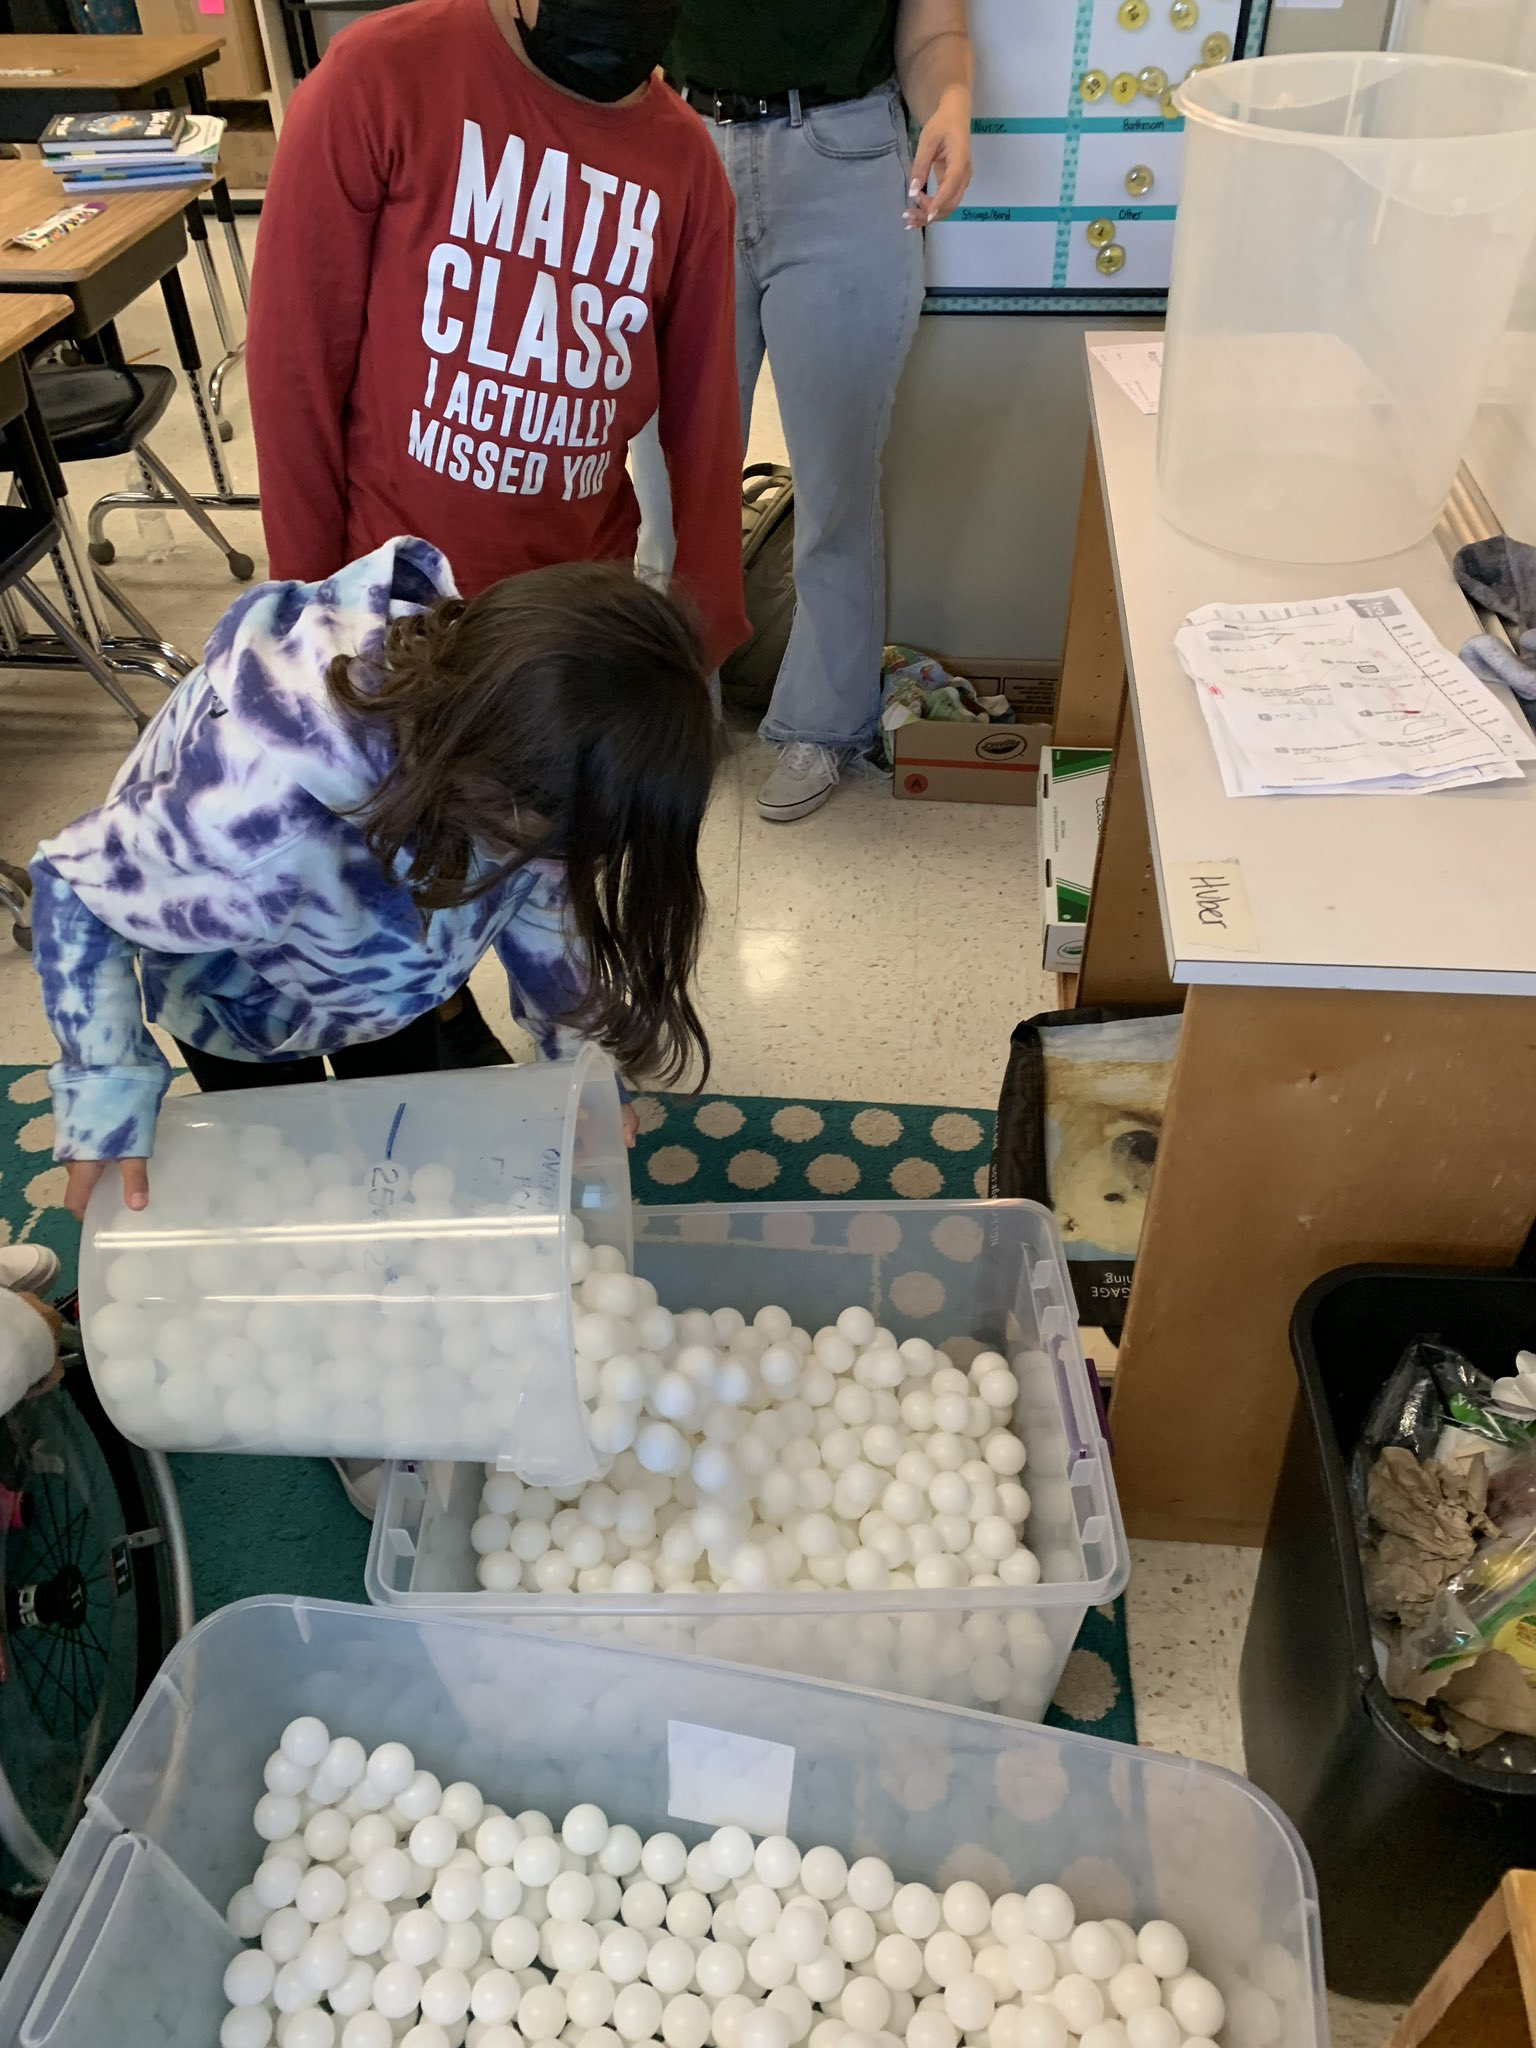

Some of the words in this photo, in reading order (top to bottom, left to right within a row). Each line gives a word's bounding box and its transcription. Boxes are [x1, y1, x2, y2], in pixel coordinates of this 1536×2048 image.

[1126, 4, 1140, 21] 14
[1085, 78, 1102, 95] 19
[1119, 81, 1128, 93] 5
[973, 121, 1008, 133] Nurse
[1122, 119, 1165, 130] Bathroom
[449, 118, 661, 294] MATH
[1118, 208, 1143, 220] Other
[421, 243, 649, 391] CLASS
[424, 357, 438, 408] I
[443, 371, 617, 447] ACTUALLY
[407, 409, 548, 495] MISSED
[561, 451, 610, 501] YOU
[1362, 606, 1386, 618] 13
[911, 778, 923, 789] A
[1189, 875, 1230, 930] Huber
[1090, 1285, 1132, 1299] GAGE
